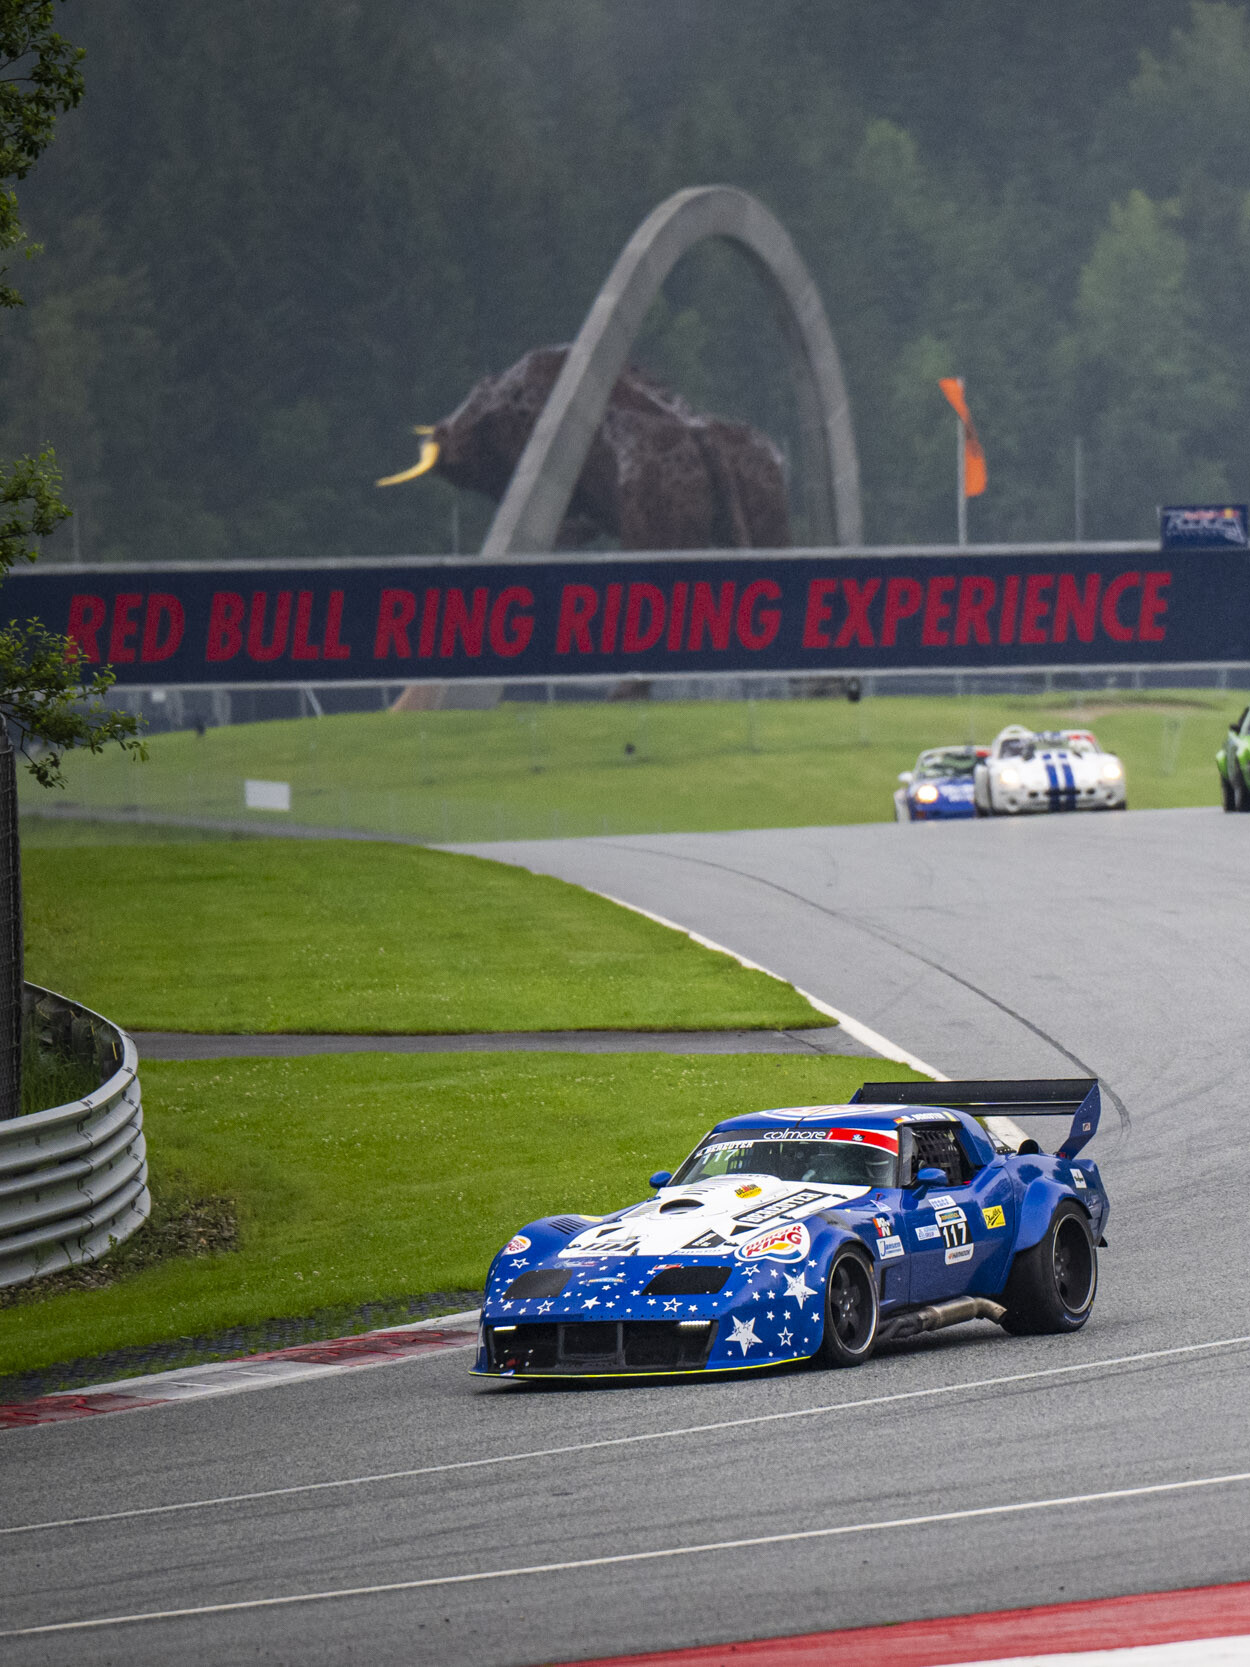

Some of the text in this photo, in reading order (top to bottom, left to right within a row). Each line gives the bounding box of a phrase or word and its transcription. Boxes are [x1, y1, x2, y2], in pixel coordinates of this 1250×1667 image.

[65, 571, 1173, 665] RED BULL RING RIDING EXPERIENCE
[763, 1128, 827, 1140] colmore
[701, 1148, 738, 1166] 117
[746, 1231, 803, 1258] KING
[942, 1221, 968, 1249] 117
